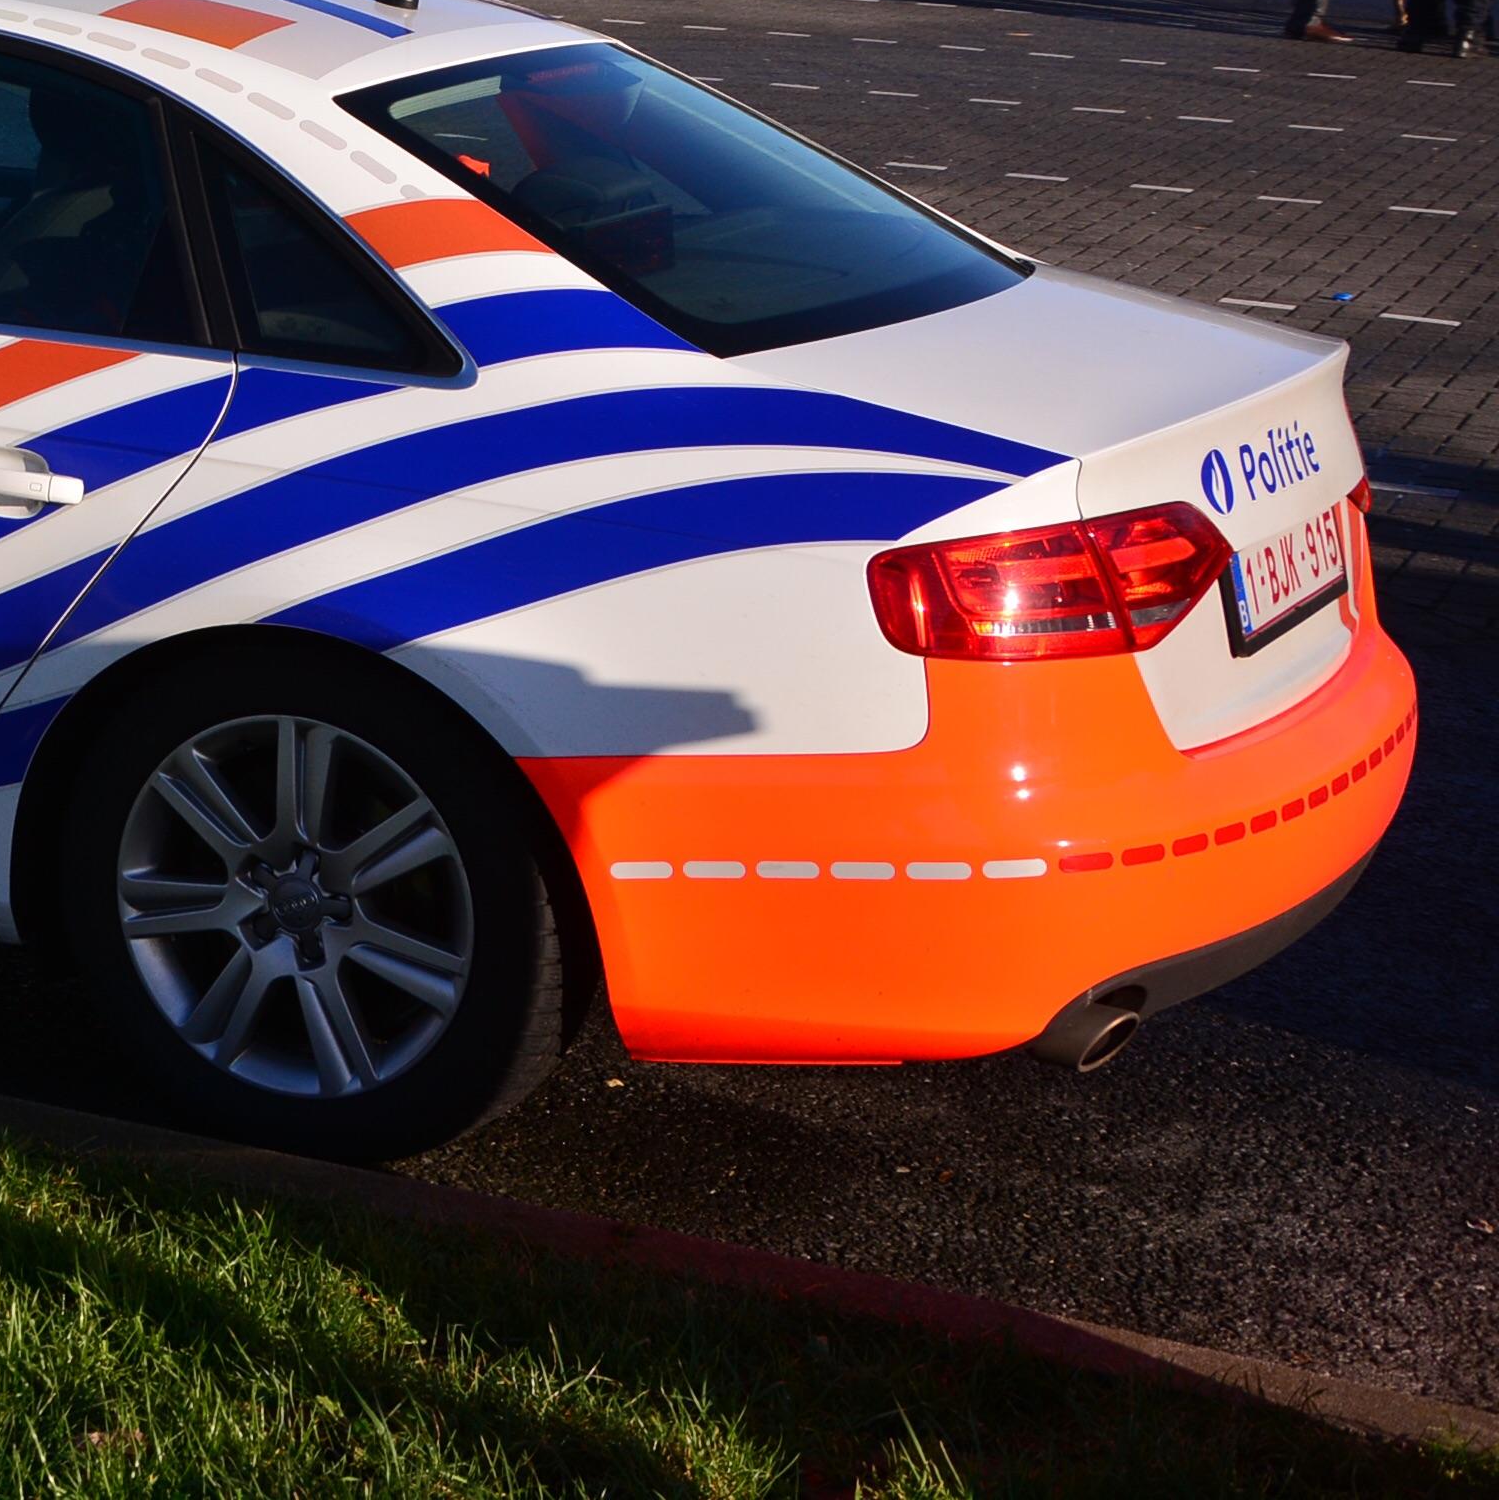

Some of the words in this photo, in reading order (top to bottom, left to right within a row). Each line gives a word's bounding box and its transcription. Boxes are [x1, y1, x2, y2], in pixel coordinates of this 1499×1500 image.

[1239, 420, 1321, 501] Politie
[1238, 599, 1250, 629] B
[1246, 510, 1338, 616] 1-BJK-915
